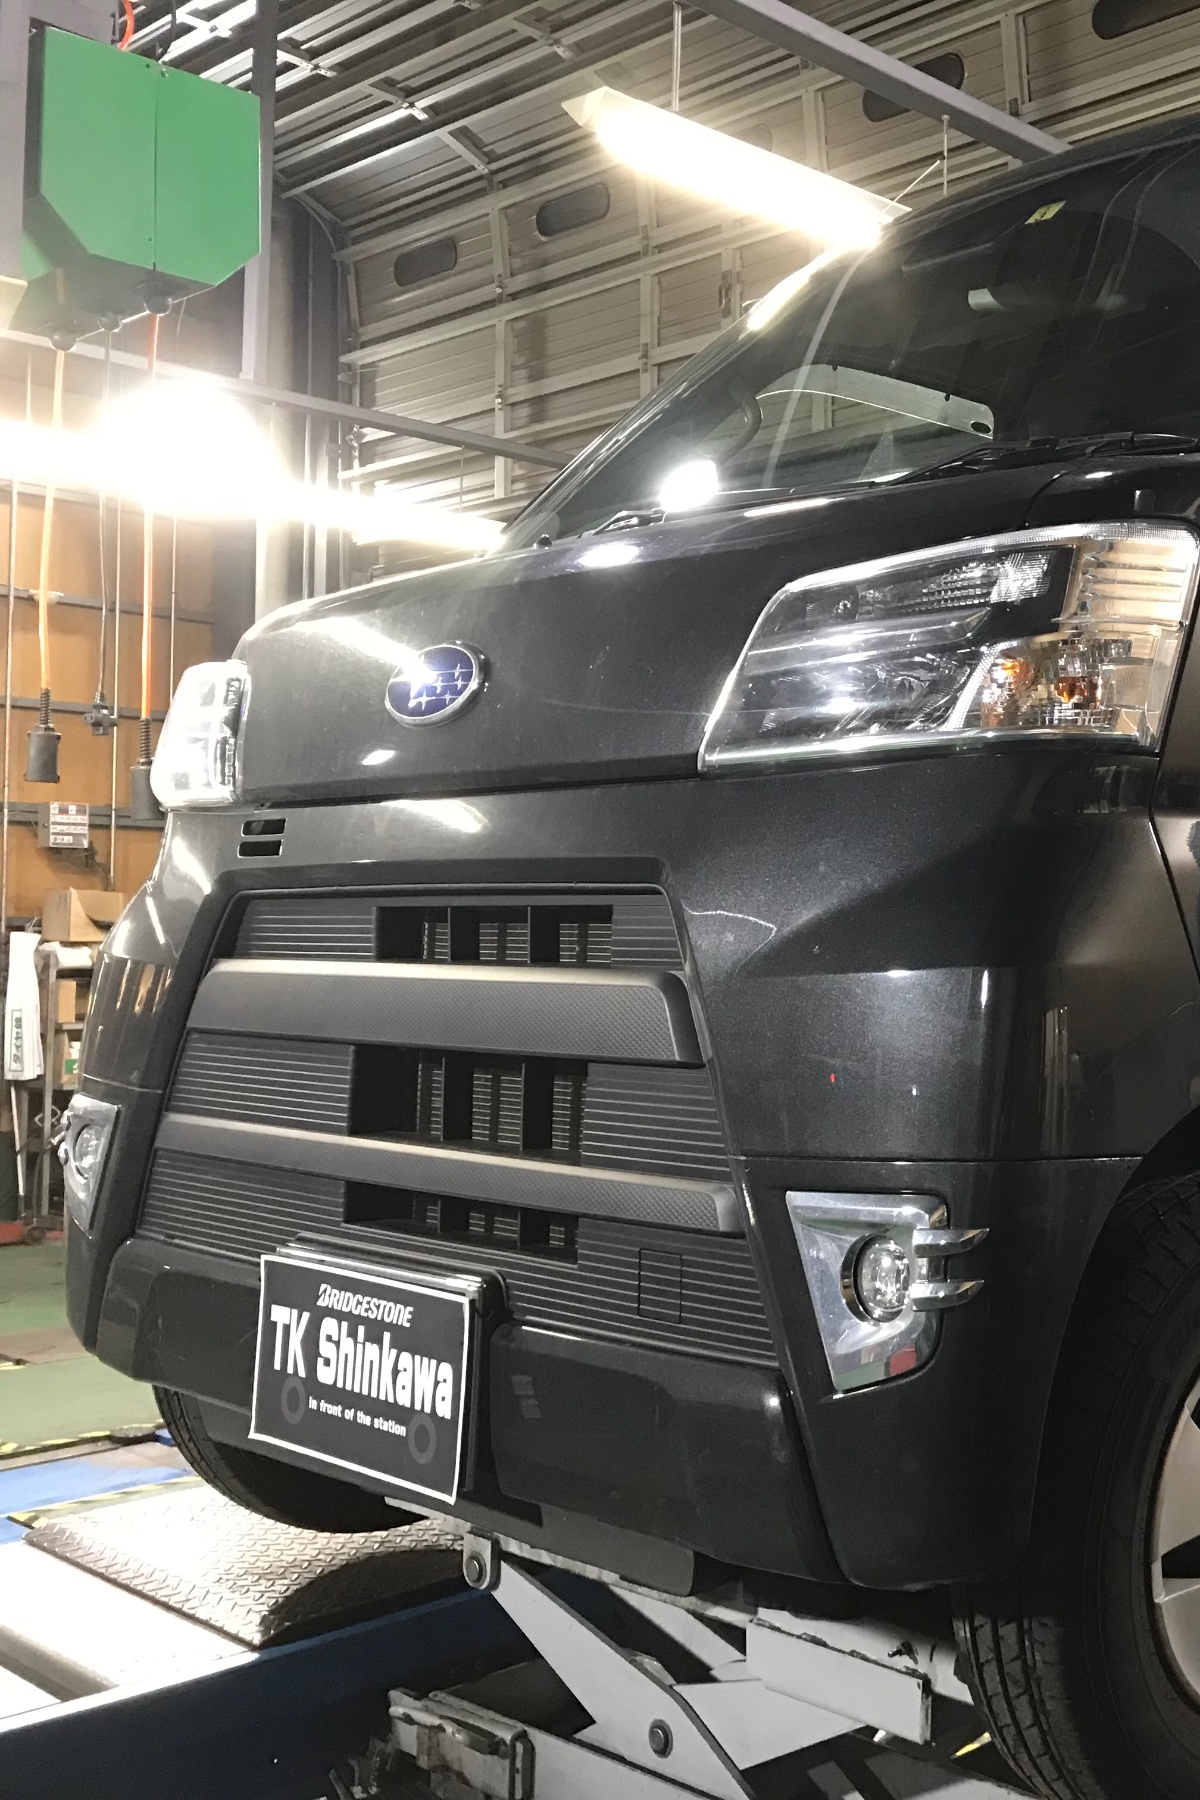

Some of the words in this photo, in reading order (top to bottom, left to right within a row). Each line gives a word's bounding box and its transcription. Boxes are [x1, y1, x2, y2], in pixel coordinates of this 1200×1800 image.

[316, 1283, 414, 1328] BRIDGESTONE
[270, 1304, 310, 1378] TK
[316, 1316, 453, 1420] Shinkawa
[319, 1401, 342, 1418] front
[344, 1406, 355, 1420] of
[356, 1410, 371, 1425] the
[373, 1416, 406, 1437] station
